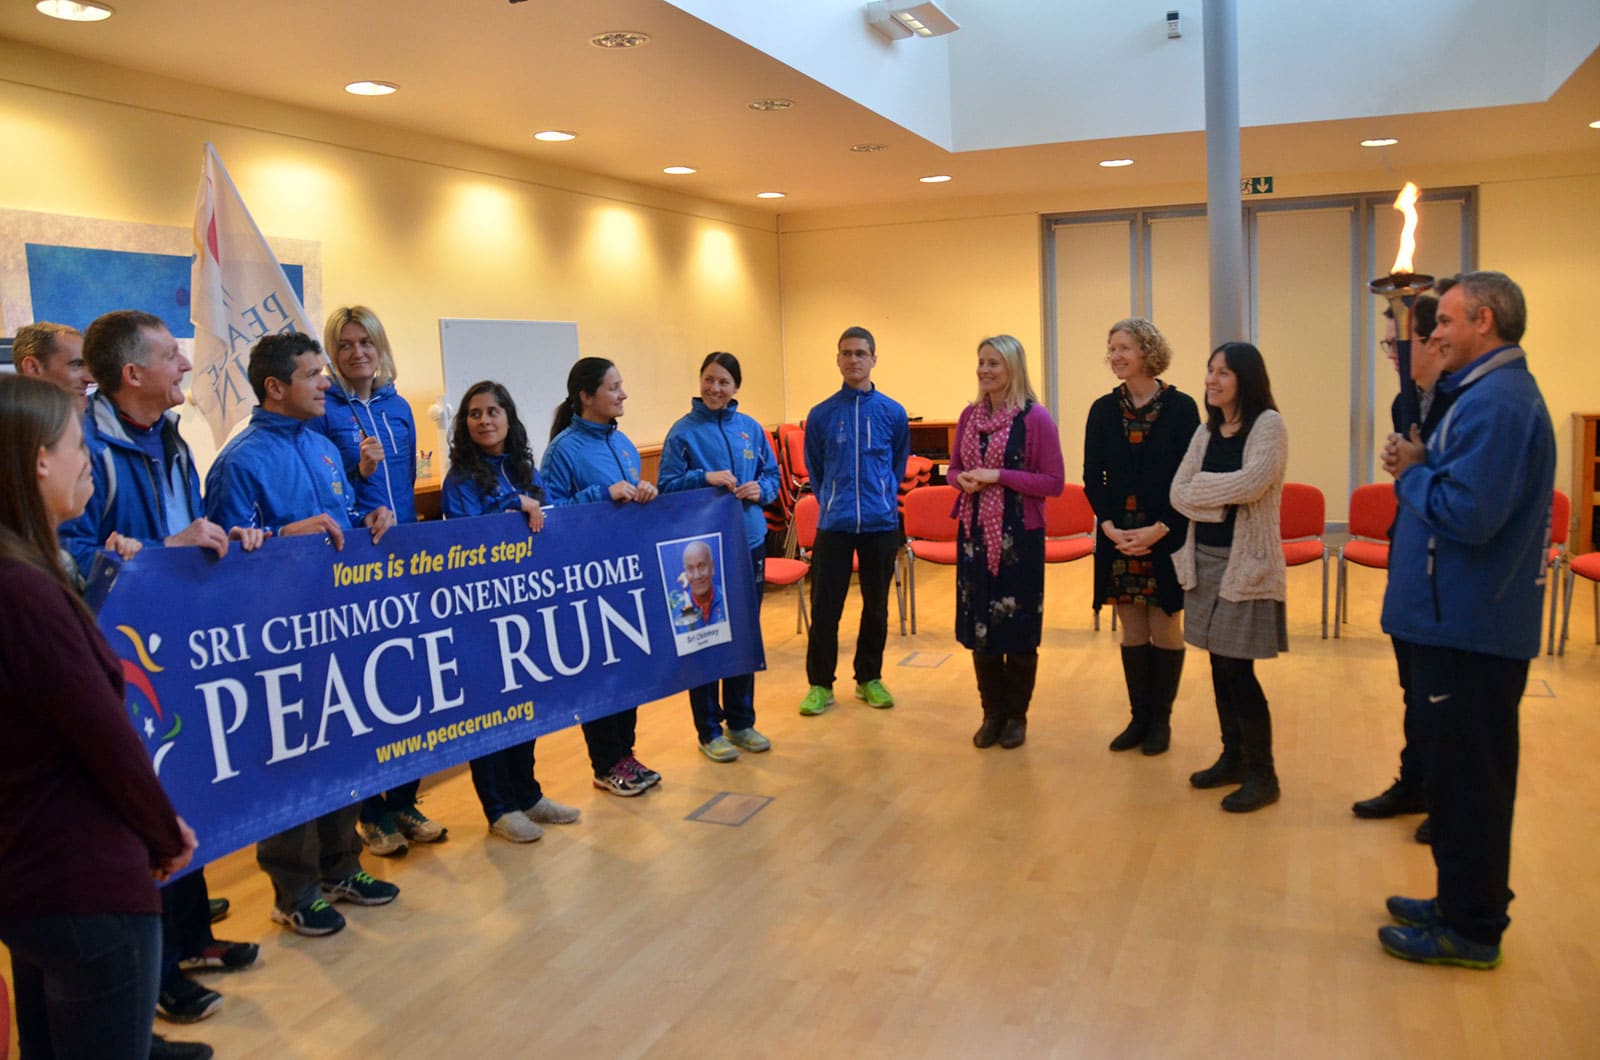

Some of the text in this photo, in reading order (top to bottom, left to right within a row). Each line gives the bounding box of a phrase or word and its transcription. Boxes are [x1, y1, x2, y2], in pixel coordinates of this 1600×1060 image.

[332, 535, 534, 588] Yours is the first step!
[188, 554, 643, 670] SRI CHINMOY ONENESS-HOME
[194, 587, 651, 784] PEACE RUN
[375, 700, 535, 764] www.peacerun.org
